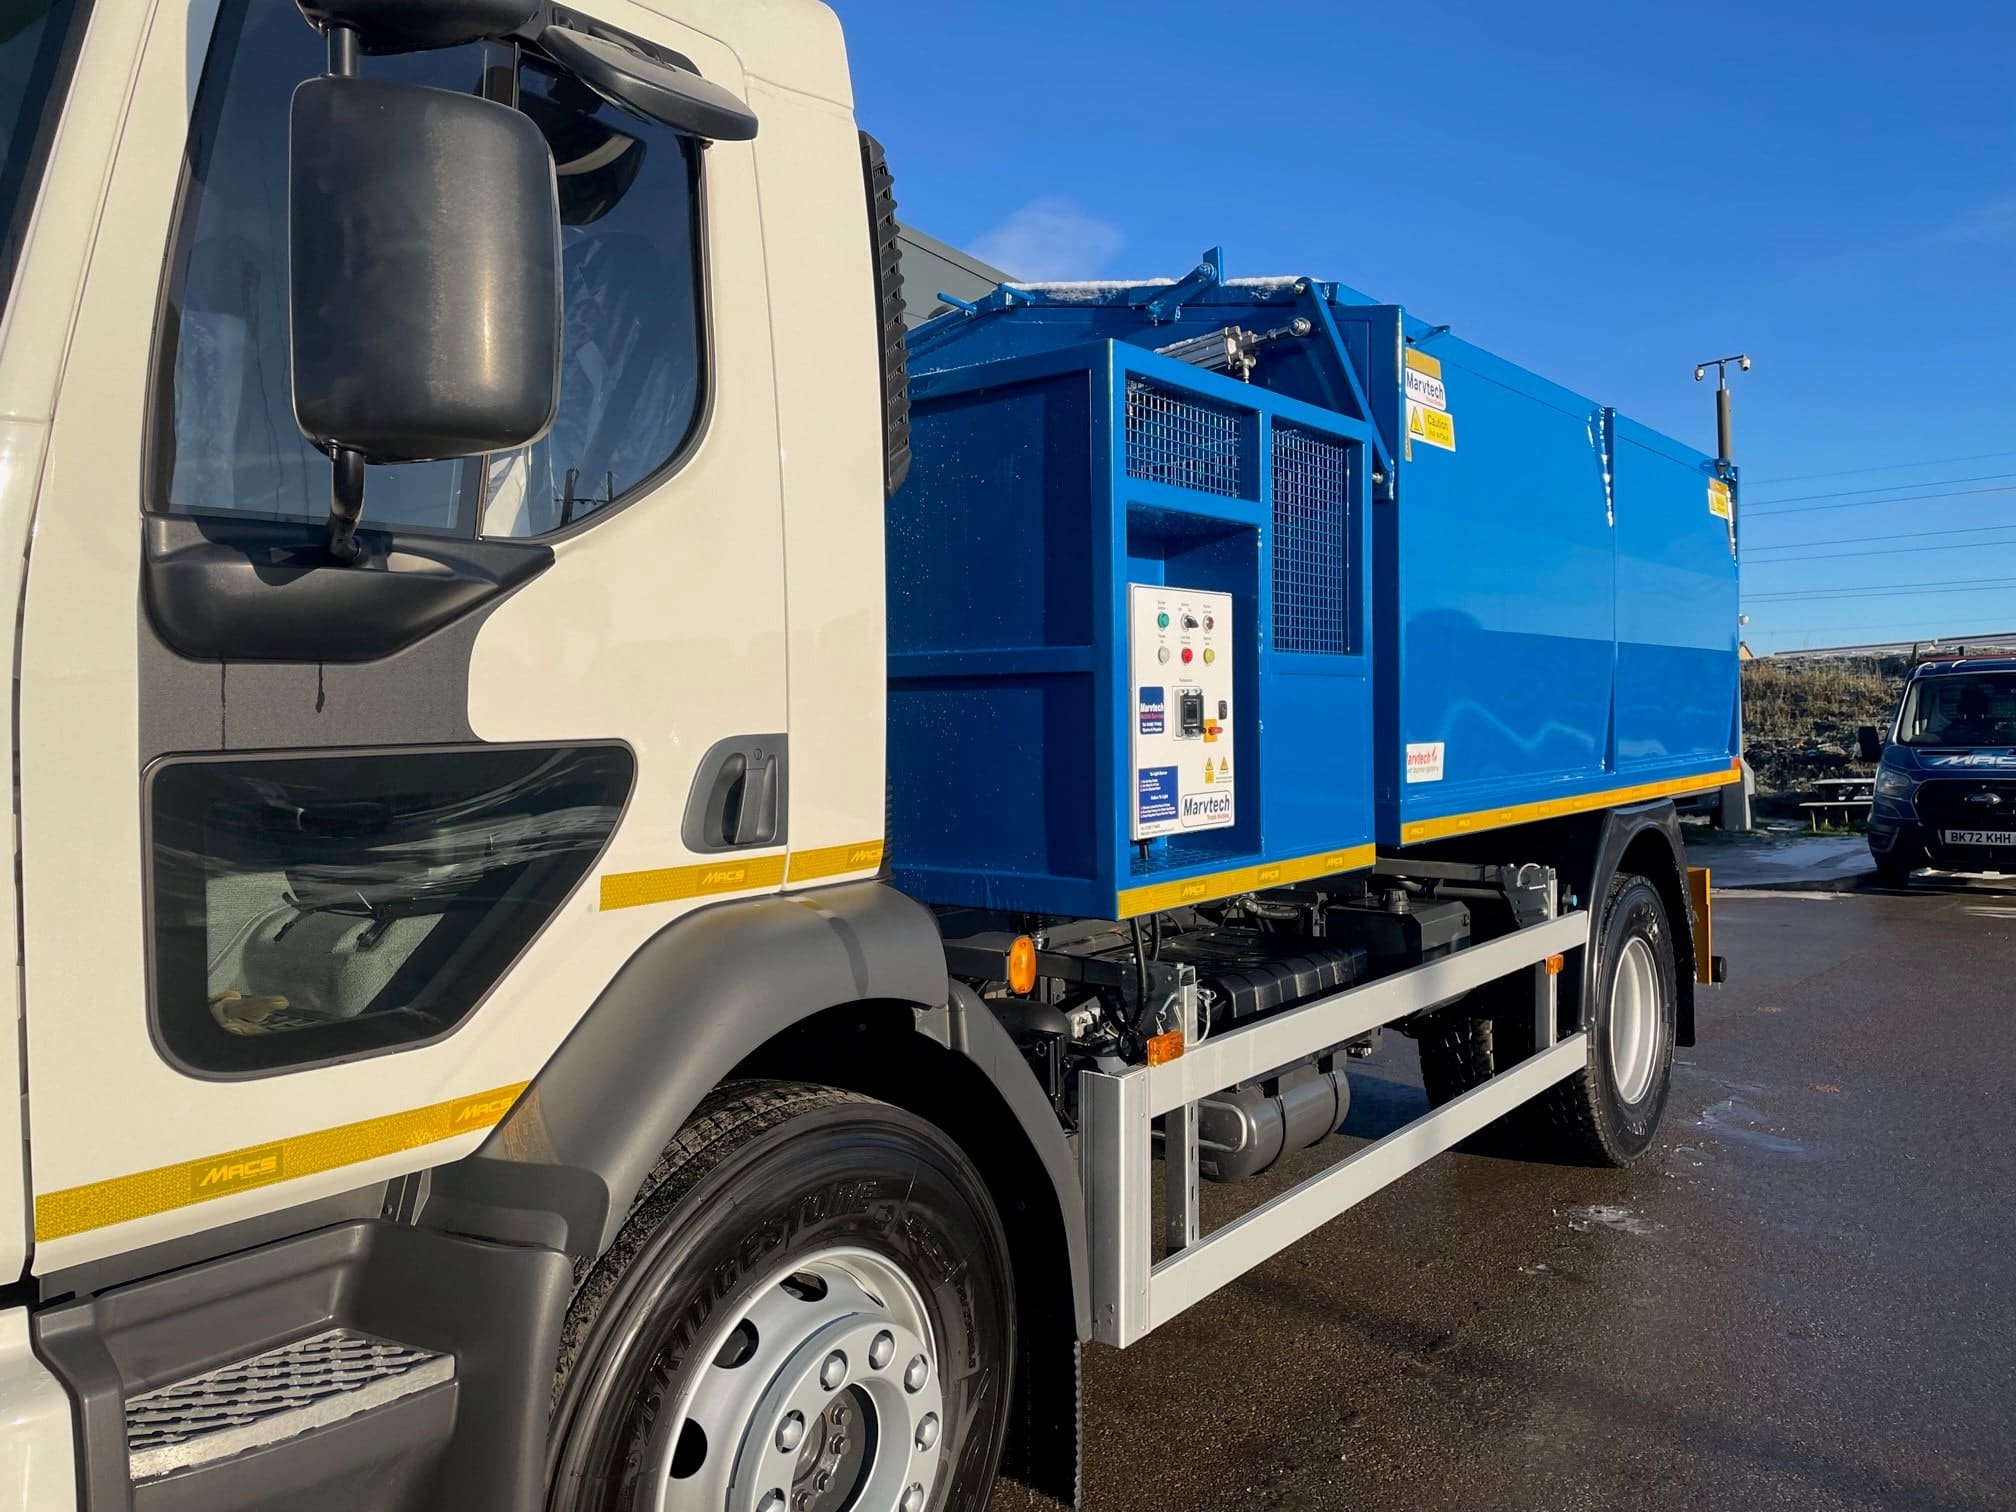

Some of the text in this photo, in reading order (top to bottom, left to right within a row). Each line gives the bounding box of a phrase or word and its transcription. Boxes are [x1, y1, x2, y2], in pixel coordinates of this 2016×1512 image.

[1406, 371, 1444, 400] Marvtech
[1427, 414, 1449, 430] Caution
[1183, 794, 1230, 817] Marvtech
[1951, 831, 2011, 844] BK72 KHH
[702, 869, 744, 885] MACS
[455, 1097, 513, 1123] MACS
[199, 1155, 277, 1187] MACS
